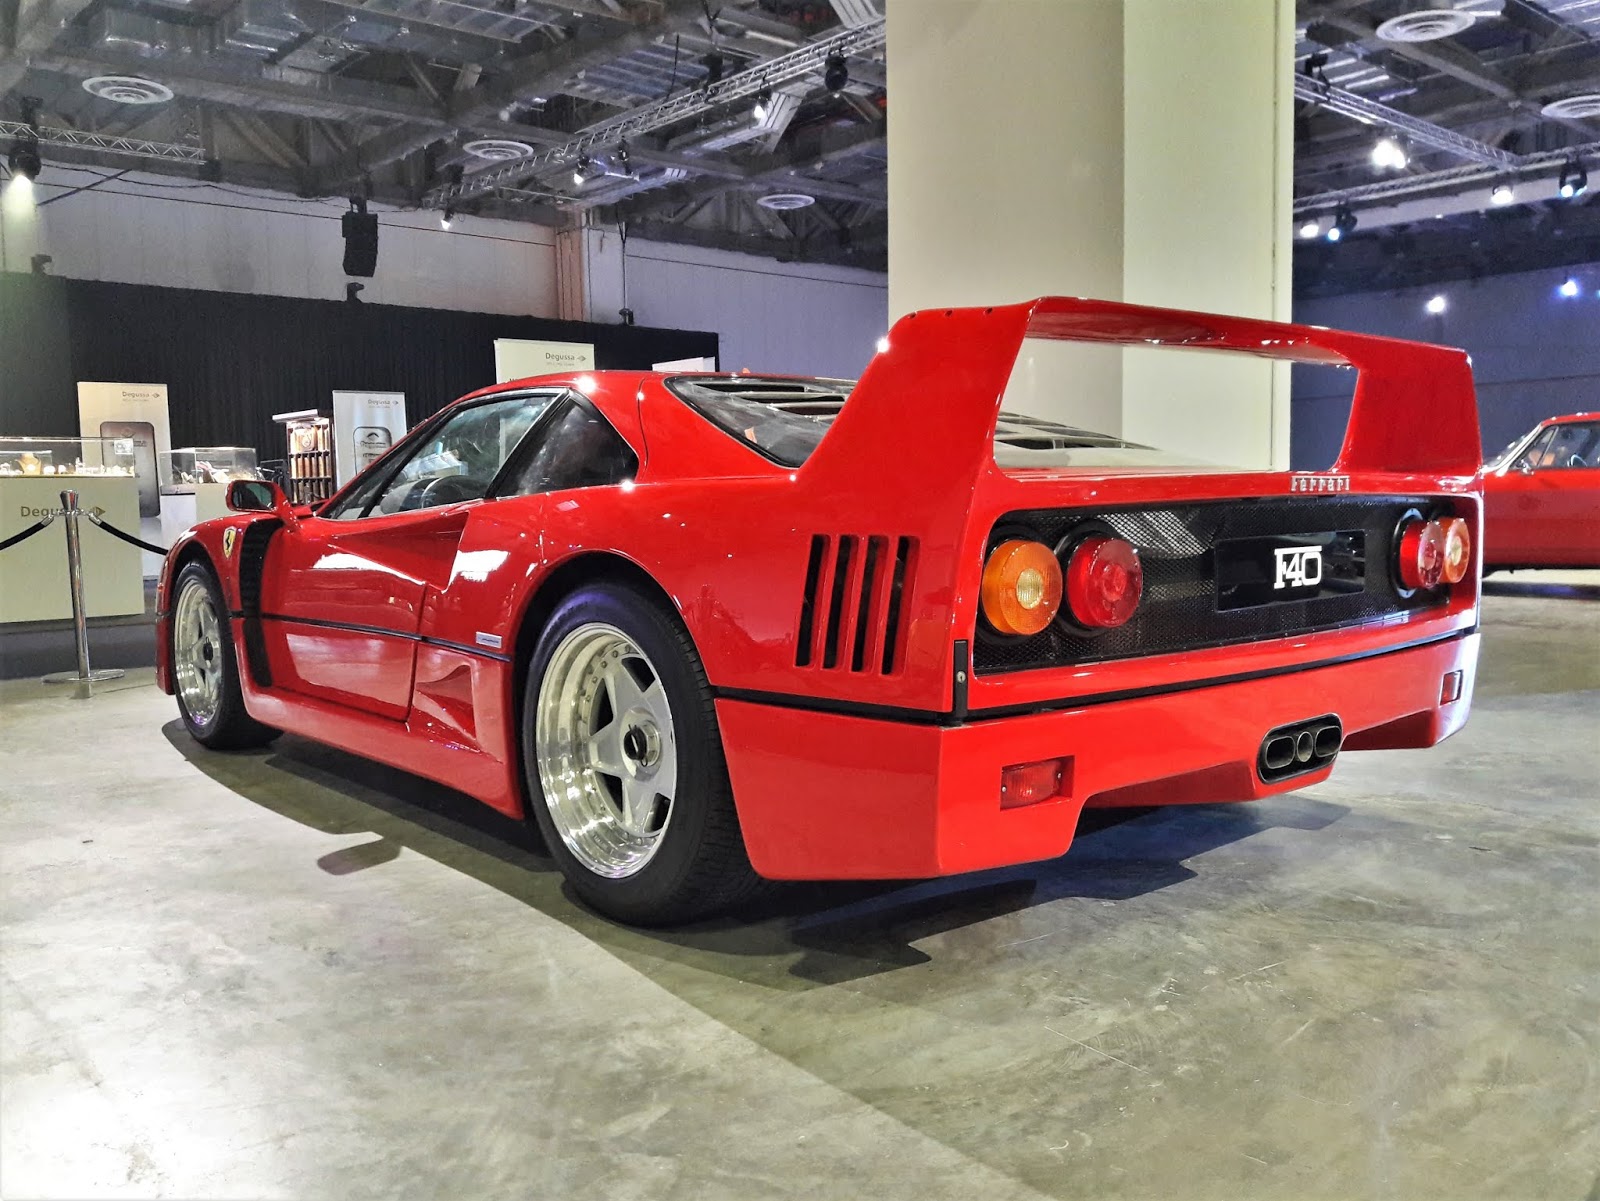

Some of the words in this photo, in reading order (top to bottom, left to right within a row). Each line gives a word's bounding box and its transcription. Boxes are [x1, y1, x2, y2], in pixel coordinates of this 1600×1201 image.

[545, 352, 575, 362] Degussa
[122, 391, 150, 399] Degussa
[1291, 475, 1350, 492] Ferrari
[1274, 545, 1322, 589] F40
